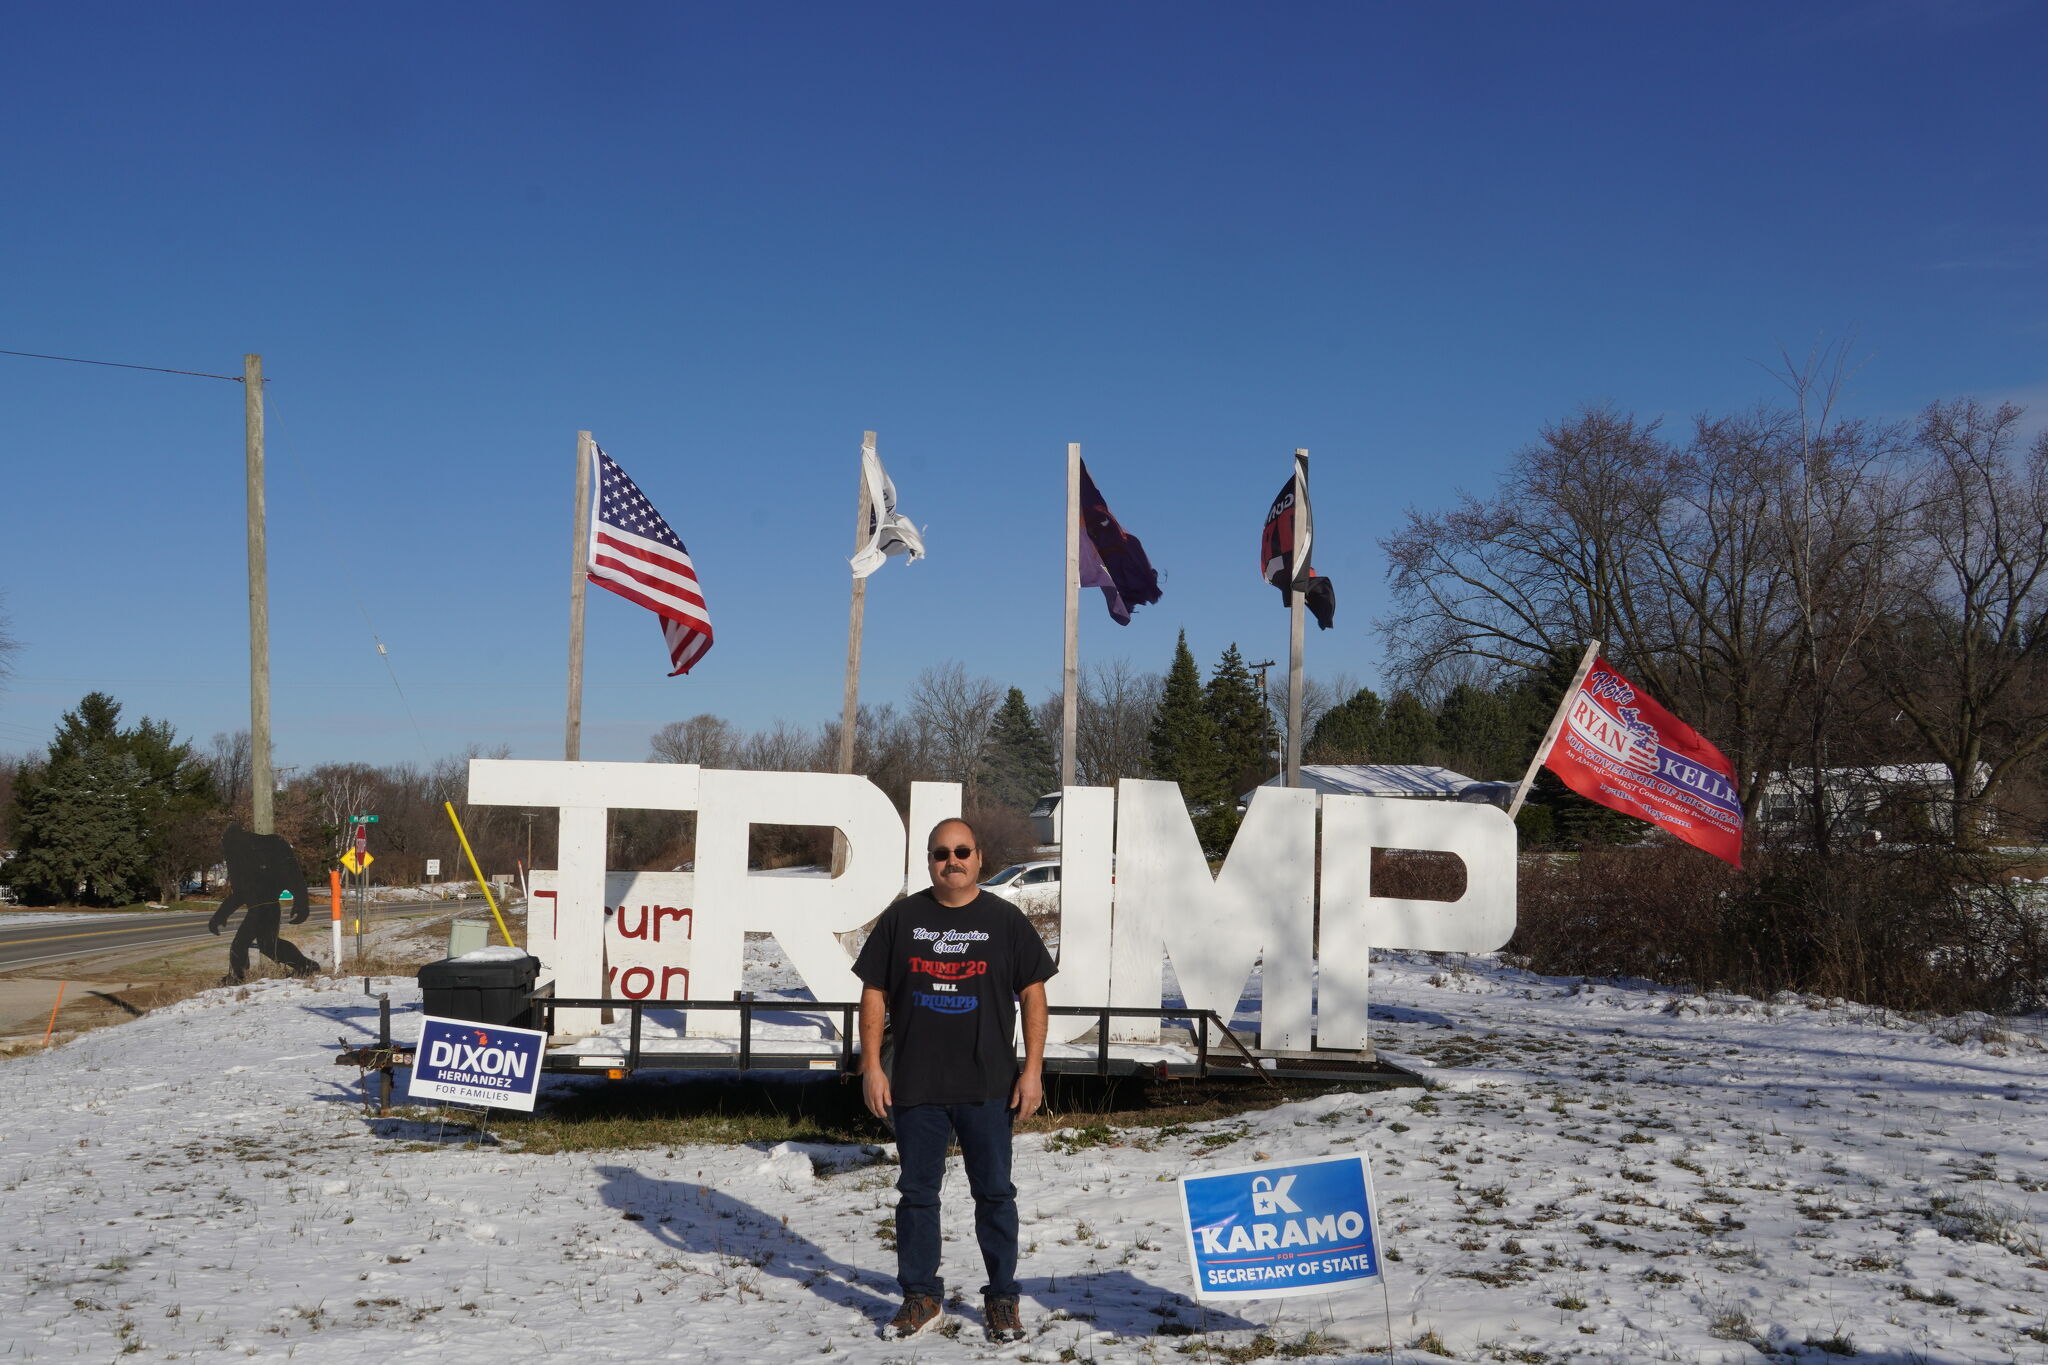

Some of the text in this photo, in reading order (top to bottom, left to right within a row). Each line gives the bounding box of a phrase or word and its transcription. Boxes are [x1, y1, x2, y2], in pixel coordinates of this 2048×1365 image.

[1592, 671, 1636, 705] Vote
[1573, 700, 1741, 811] RYAN KELLE
[1584, 749, 1657, 789] GOVERNOR
[1657, 783, 1678, 797] OF
[1639, 788, 1690, 814] Conservative
[1691, 811, 1736, 834] Republican
[468, 758, 1518, 1051] TRUMP
[913, 928, 990, 942] Keep America
[933, 941, 969, 954] Great!
[912, 992, 979, 1012] TRIUMPH
[932, 983, 959, 992] WILL
[429, 1040, 529, 1079] DIXON
[435, 1084, 456, 1095] FOR
[460, 1087, 509, 1101] FAMILIES
[438, 1069, 512, 1088] HERNANDEZ
[1200, 1210, 1364, 1255] KARAMO
[1207, 1263, 1296, 1285] SECRETARY
[1298, 1261, 1319, 1276] OF
[1323, 1254, 1369, 1273] STATE
